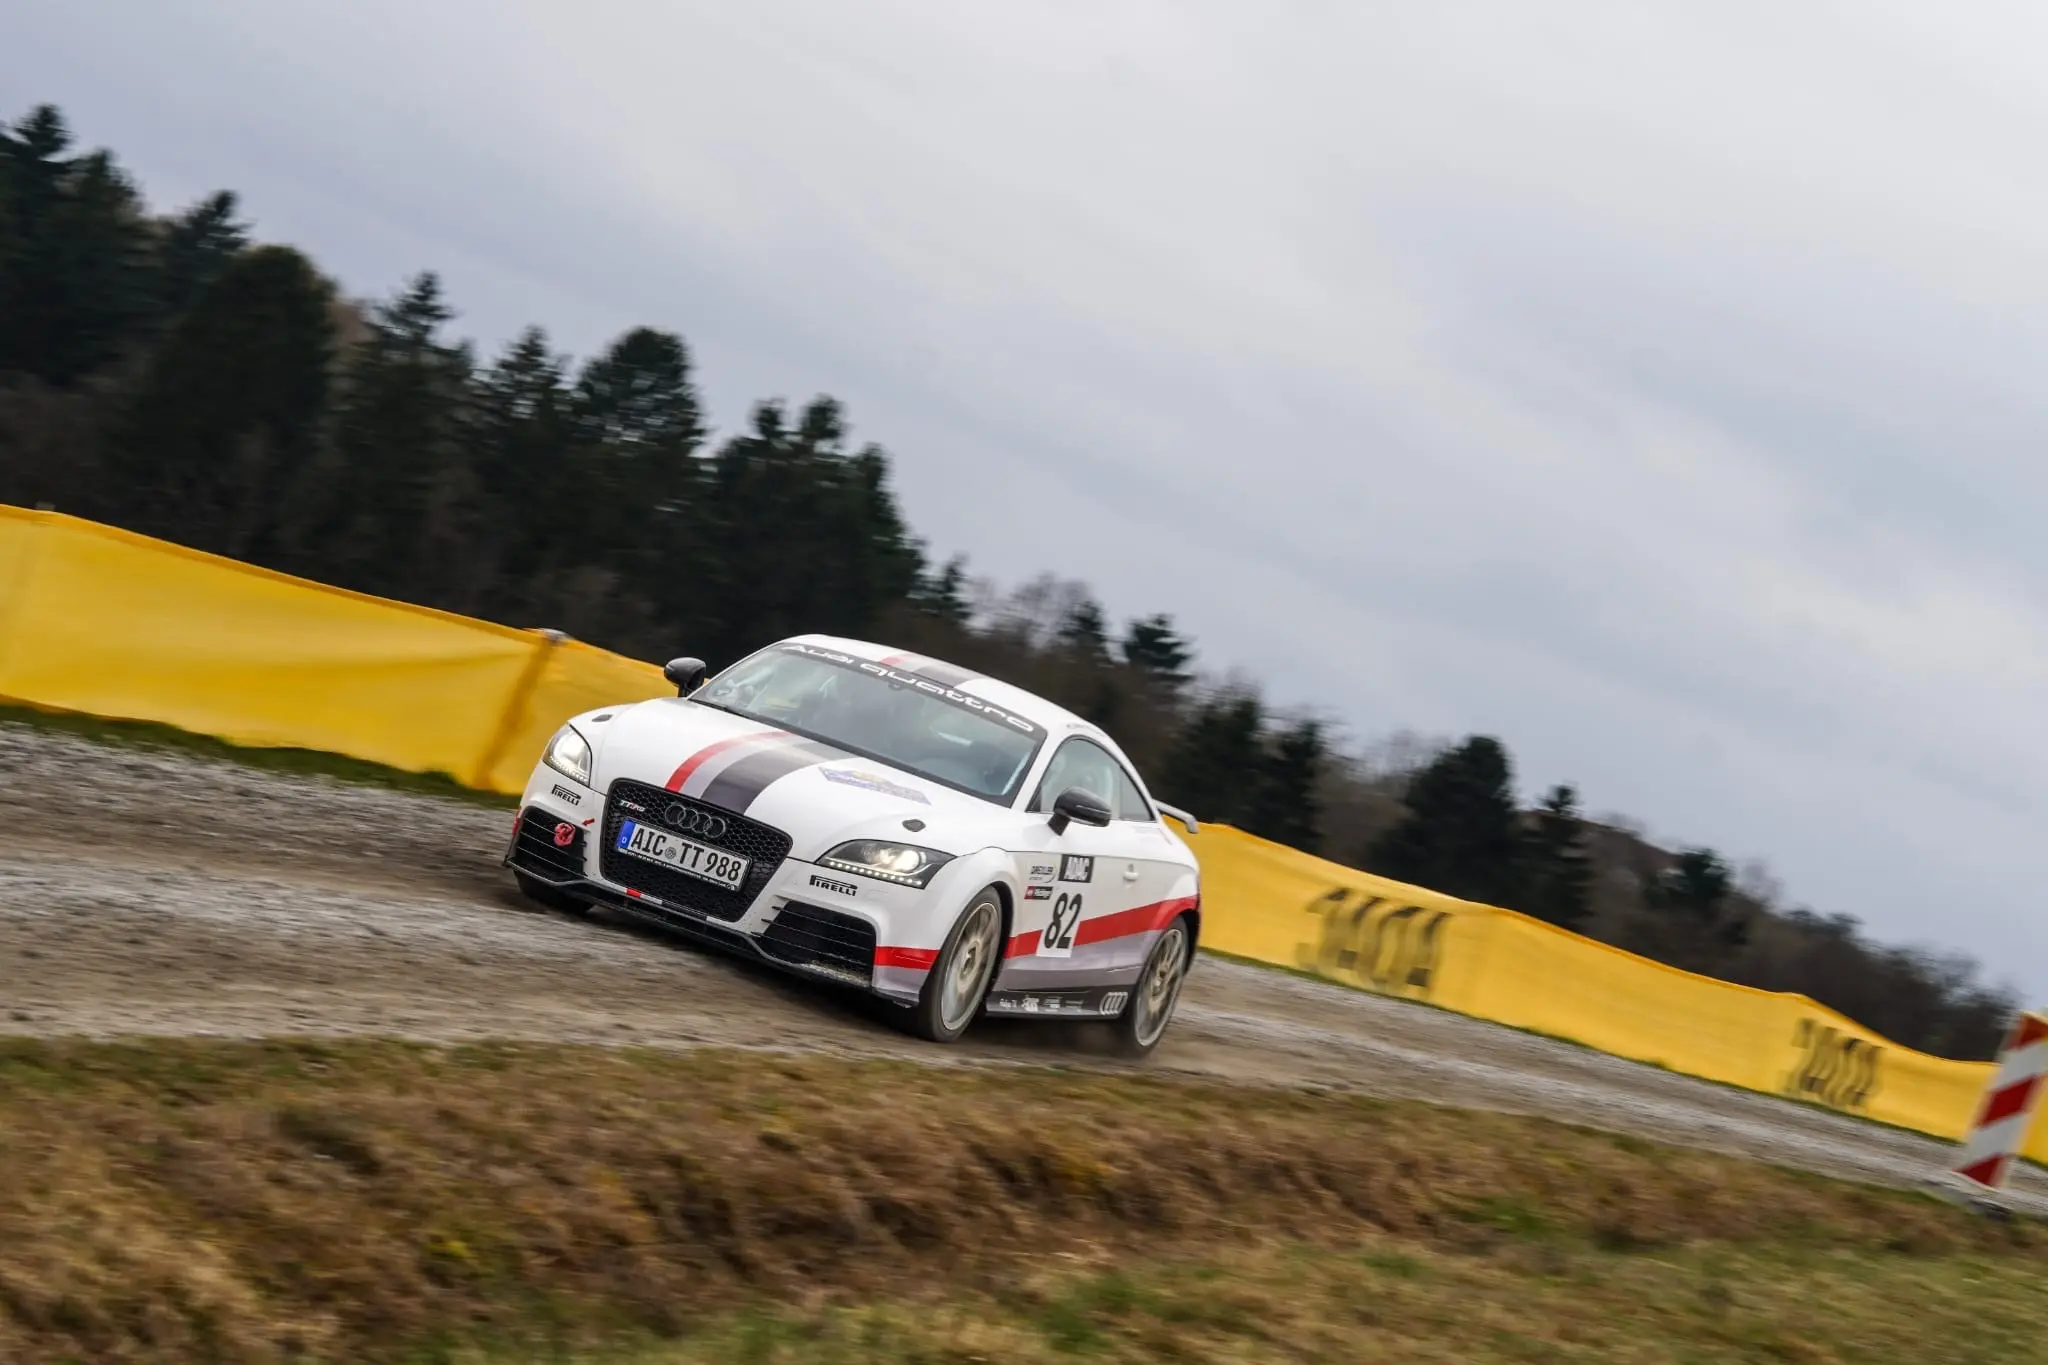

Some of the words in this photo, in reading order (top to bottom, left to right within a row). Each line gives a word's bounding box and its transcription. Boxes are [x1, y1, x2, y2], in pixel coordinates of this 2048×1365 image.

[782, 644, 855, 664] Audi
[859, 662, 1035, 733] quattro
[552, 784, 582, 806] PIRELLI
[630, 828, 667, 857] AIC
[679, 842, 705, 869] TT
[704, 852, 742, 882] 988
[809, 875, 858, 897] PIRELLI
[1044, 892, 1082, 949] 82
